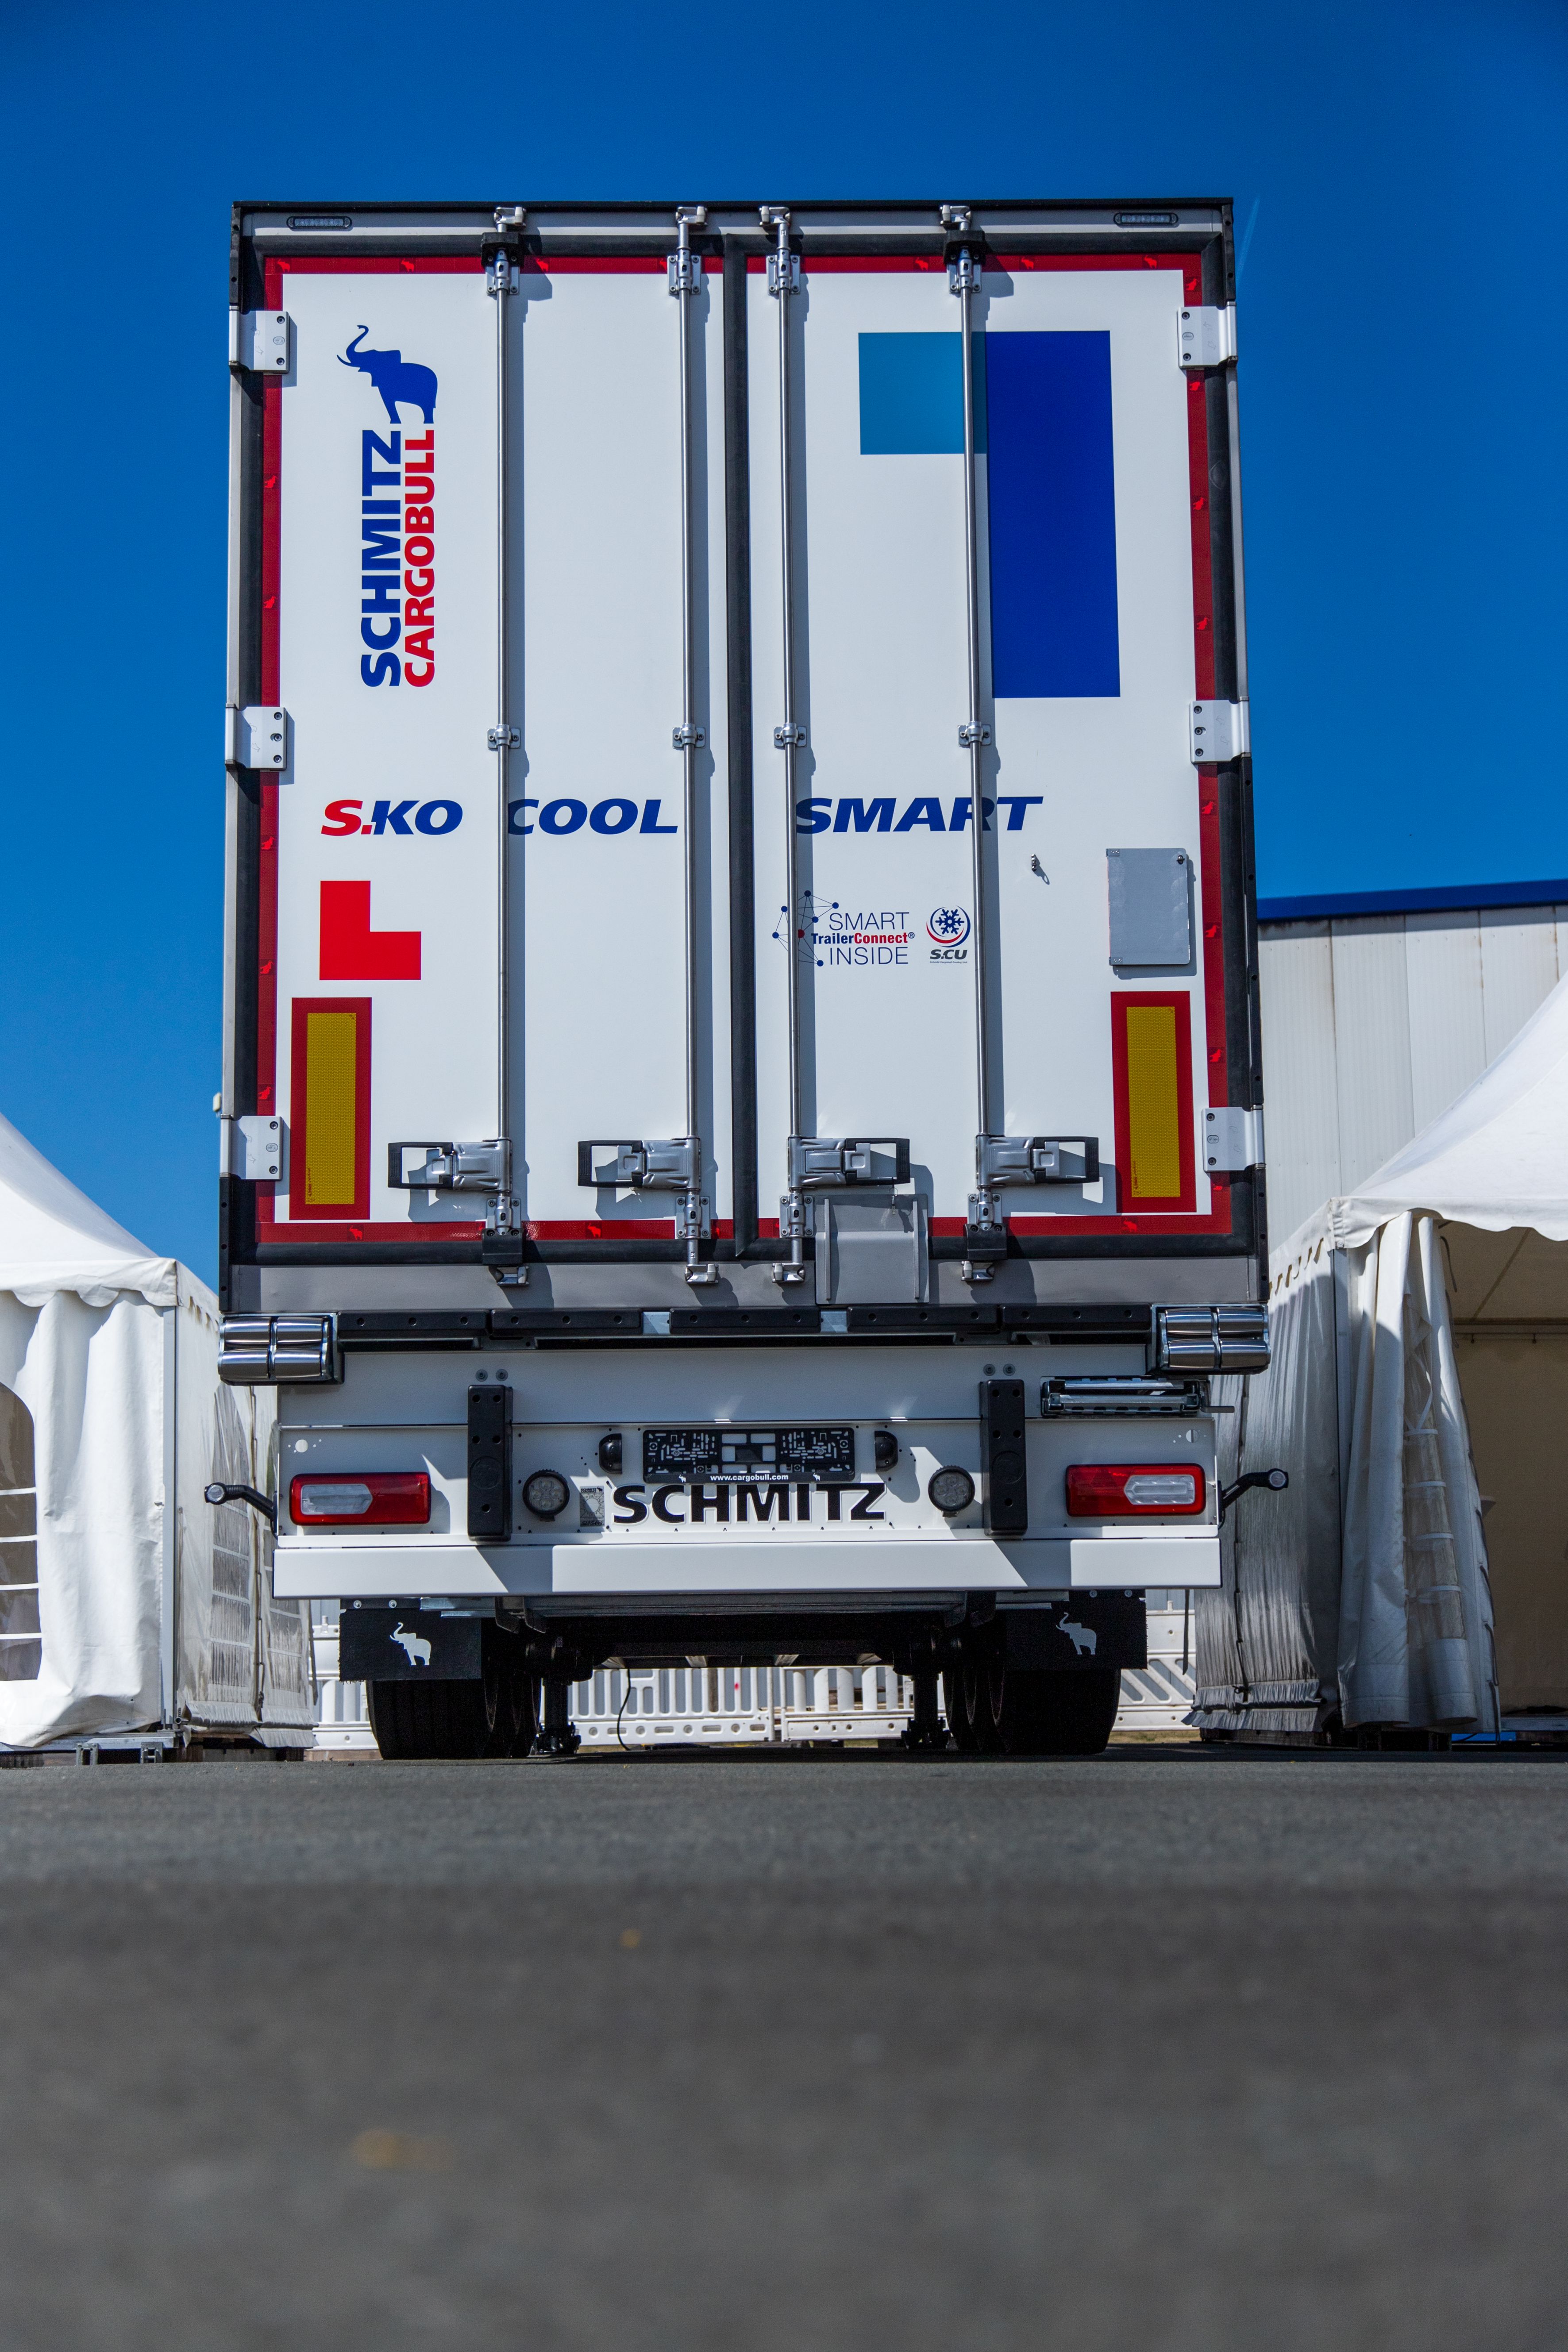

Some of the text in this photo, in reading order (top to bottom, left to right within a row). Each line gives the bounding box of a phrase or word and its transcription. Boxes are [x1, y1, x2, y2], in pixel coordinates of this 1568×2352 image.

[361, 430, 401, 687] SCHMITZ
[405, 430, 435, 687] CARGOBULL
[321, 796, 1044, 836] S.KO COOL SMART
[829, 912, 909, 931] SMART
[830, 947, 909, 965] INSIDE
[930, 949, 968, 960] S.CU
[613, 1482, 886, 1524] SCHMITZ
